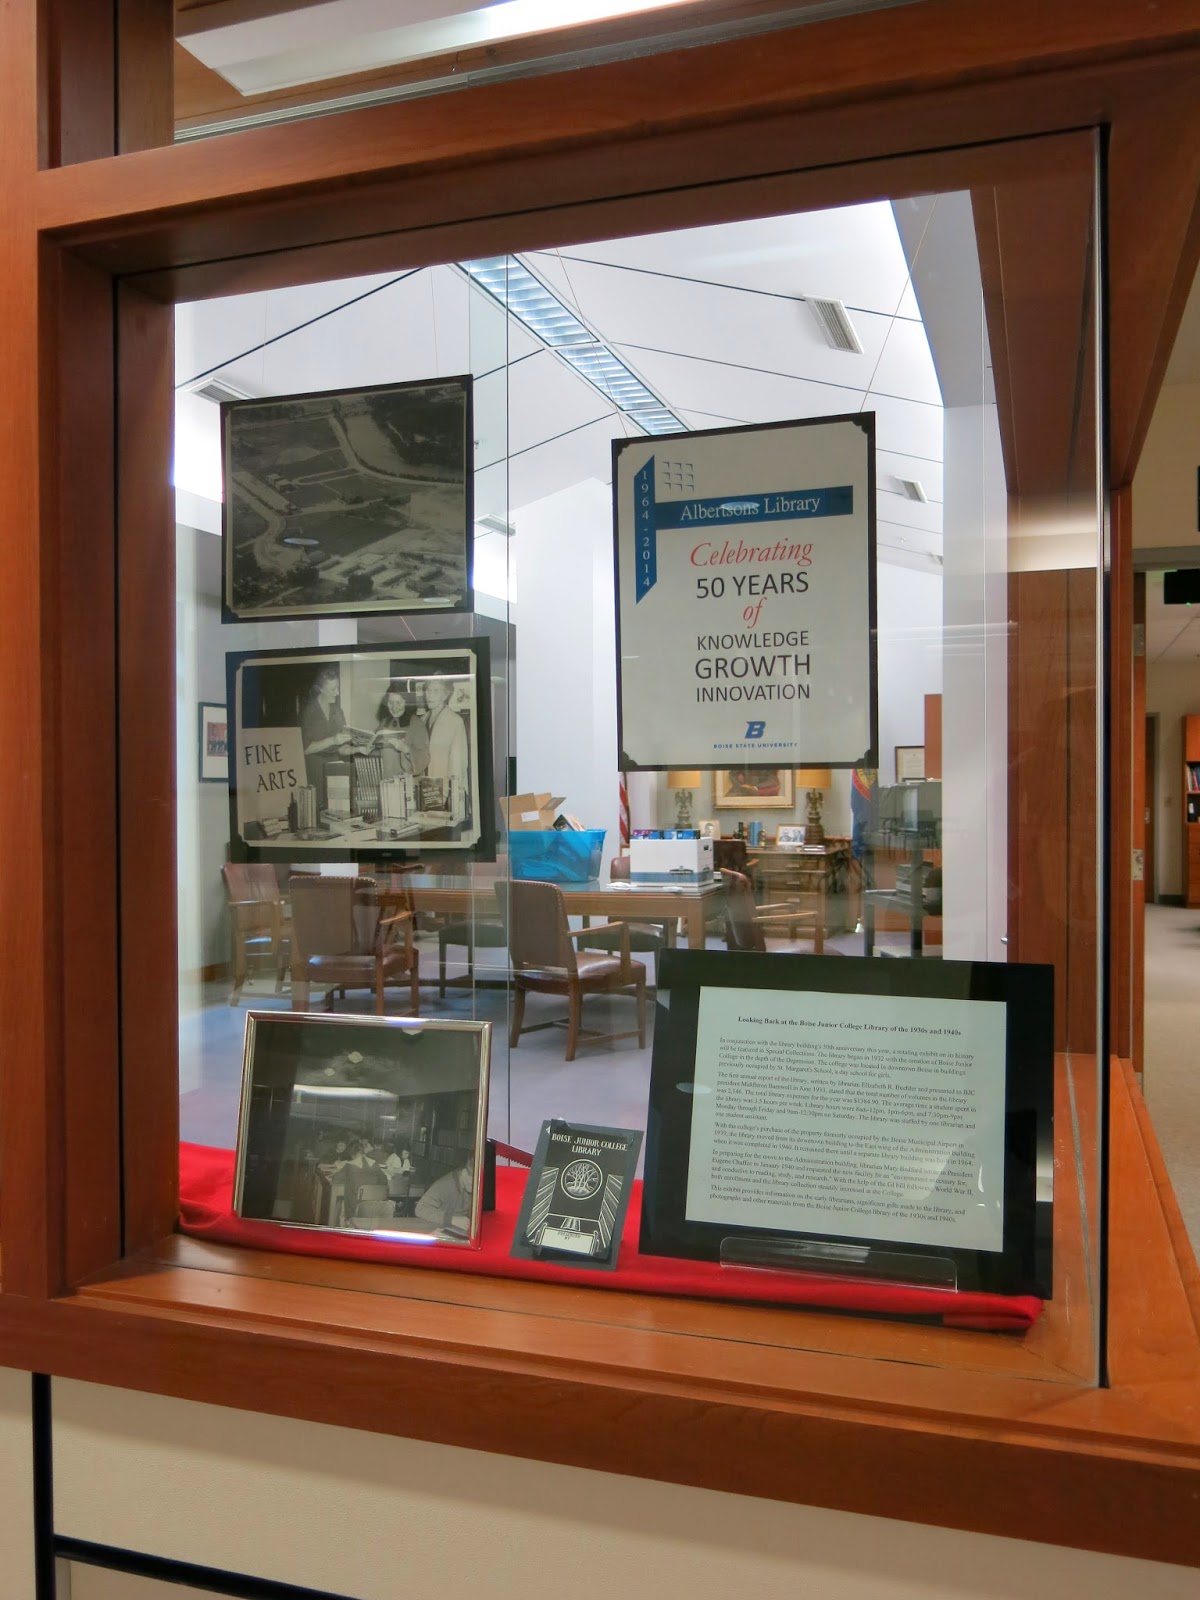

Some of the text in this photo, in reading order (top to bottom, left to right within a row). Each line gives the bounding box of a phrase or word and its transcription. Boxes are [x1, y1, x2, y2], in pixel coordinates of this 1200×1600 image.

[680, 496, 821, 521] Albertsons Library
[690, 537, 814, 568] Celebrating
[696, 571, 809, 599] 50 YEARS
[743, 596, 768, 629] of
[697, 630, 810, 651] KNOWLEDGE
[695, 653, 811, 680] GROWTH
[696, 683, 811, 703] INNOVATION
[244, 743, 283, 766] FINE
[256, 768, 298, 793] ARTS
[738, 1016, 763, 1025] Looking
[840, 1022, 862, 1031] College
[864, 1023, 888, 1033] Library
[552, 1132, 628, 1151] BOISE JUNIOR COLLEGE
[572, 1145, 602, 1156] LIBRARY
